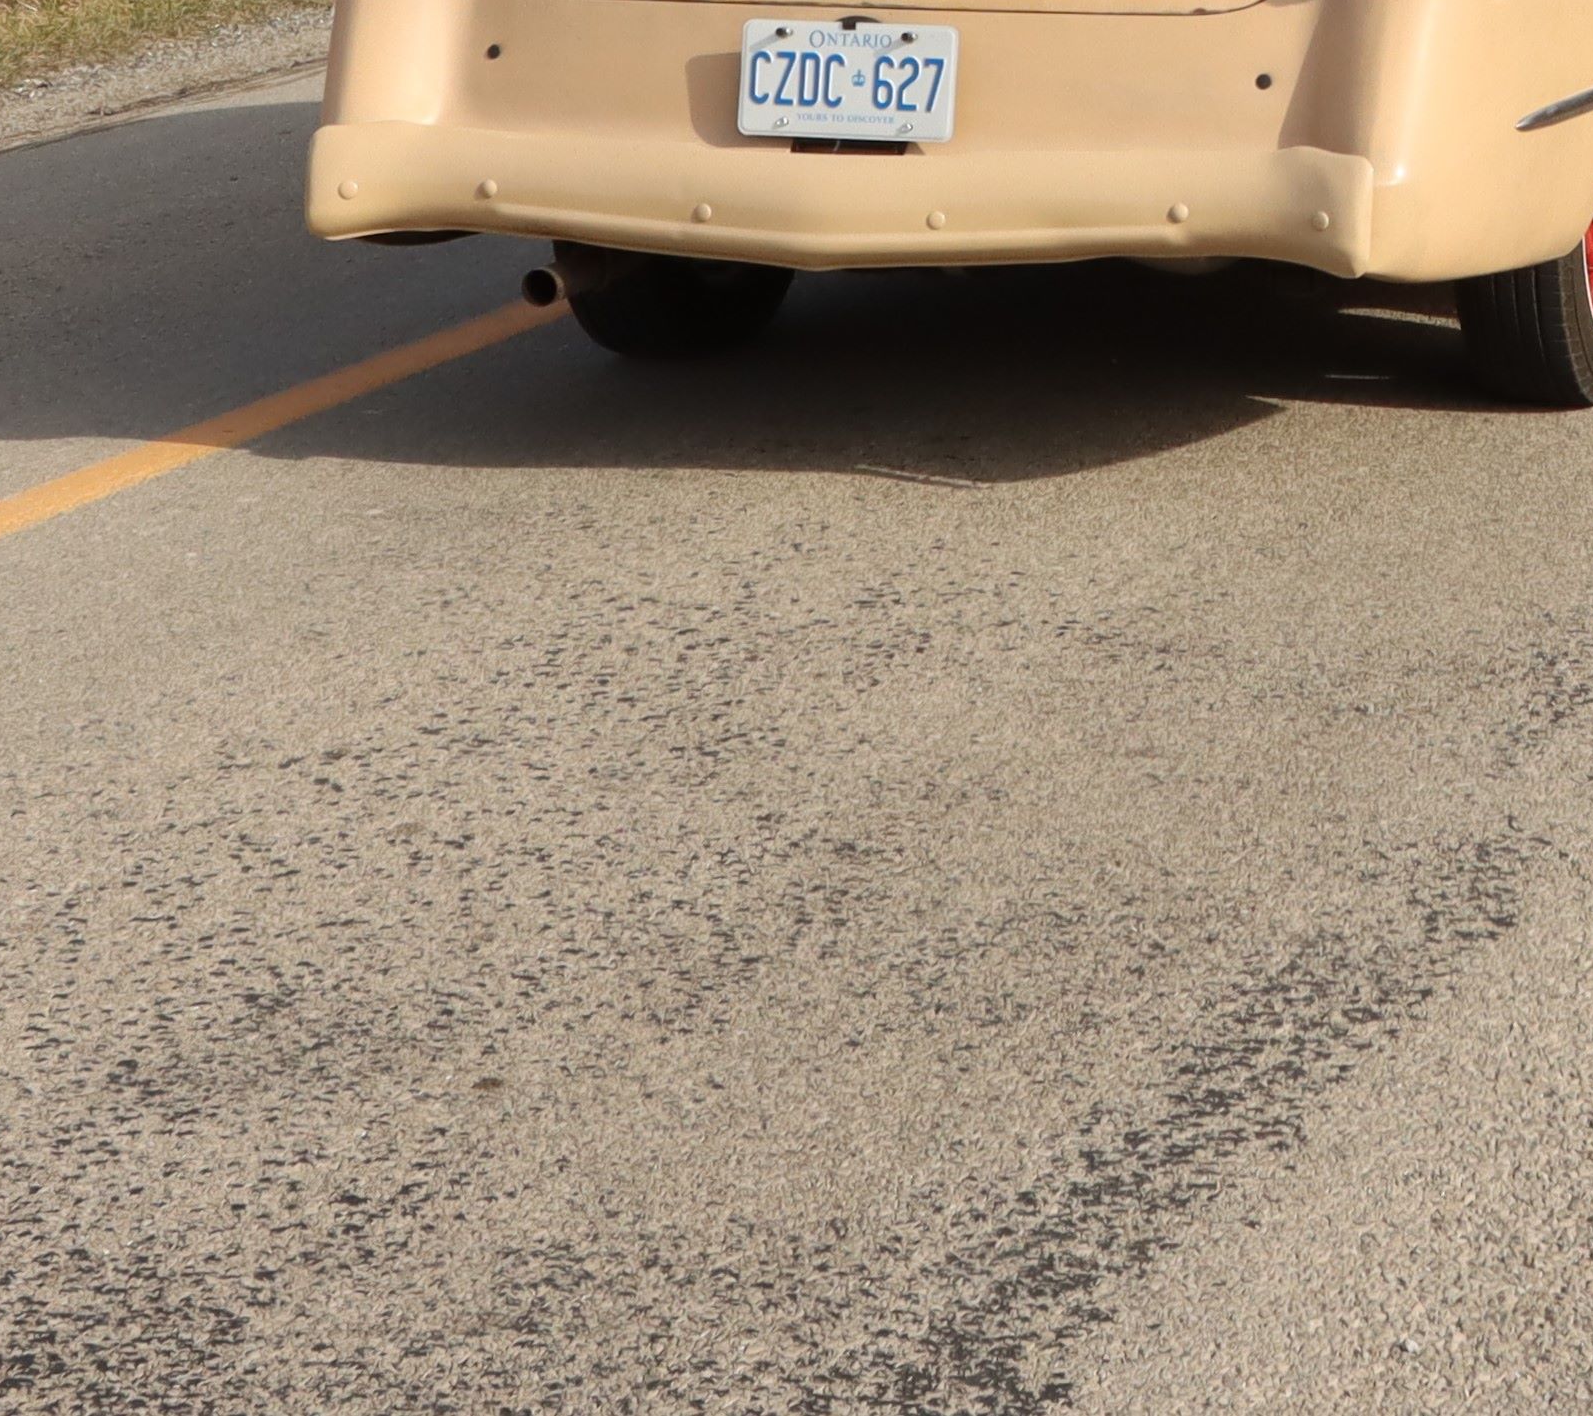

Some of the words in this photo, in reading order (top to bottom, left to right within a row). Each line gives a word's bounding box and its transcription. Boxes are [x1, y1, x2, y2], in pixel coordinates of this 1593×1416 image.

[749, 50, 846, 108] CZDC
[872, 55, 945, 113] 627
[797, 113, 828, 122] YOURS
[831, 114, 844, 123] TO
[847, 115, 895, 124] DISCOVER
